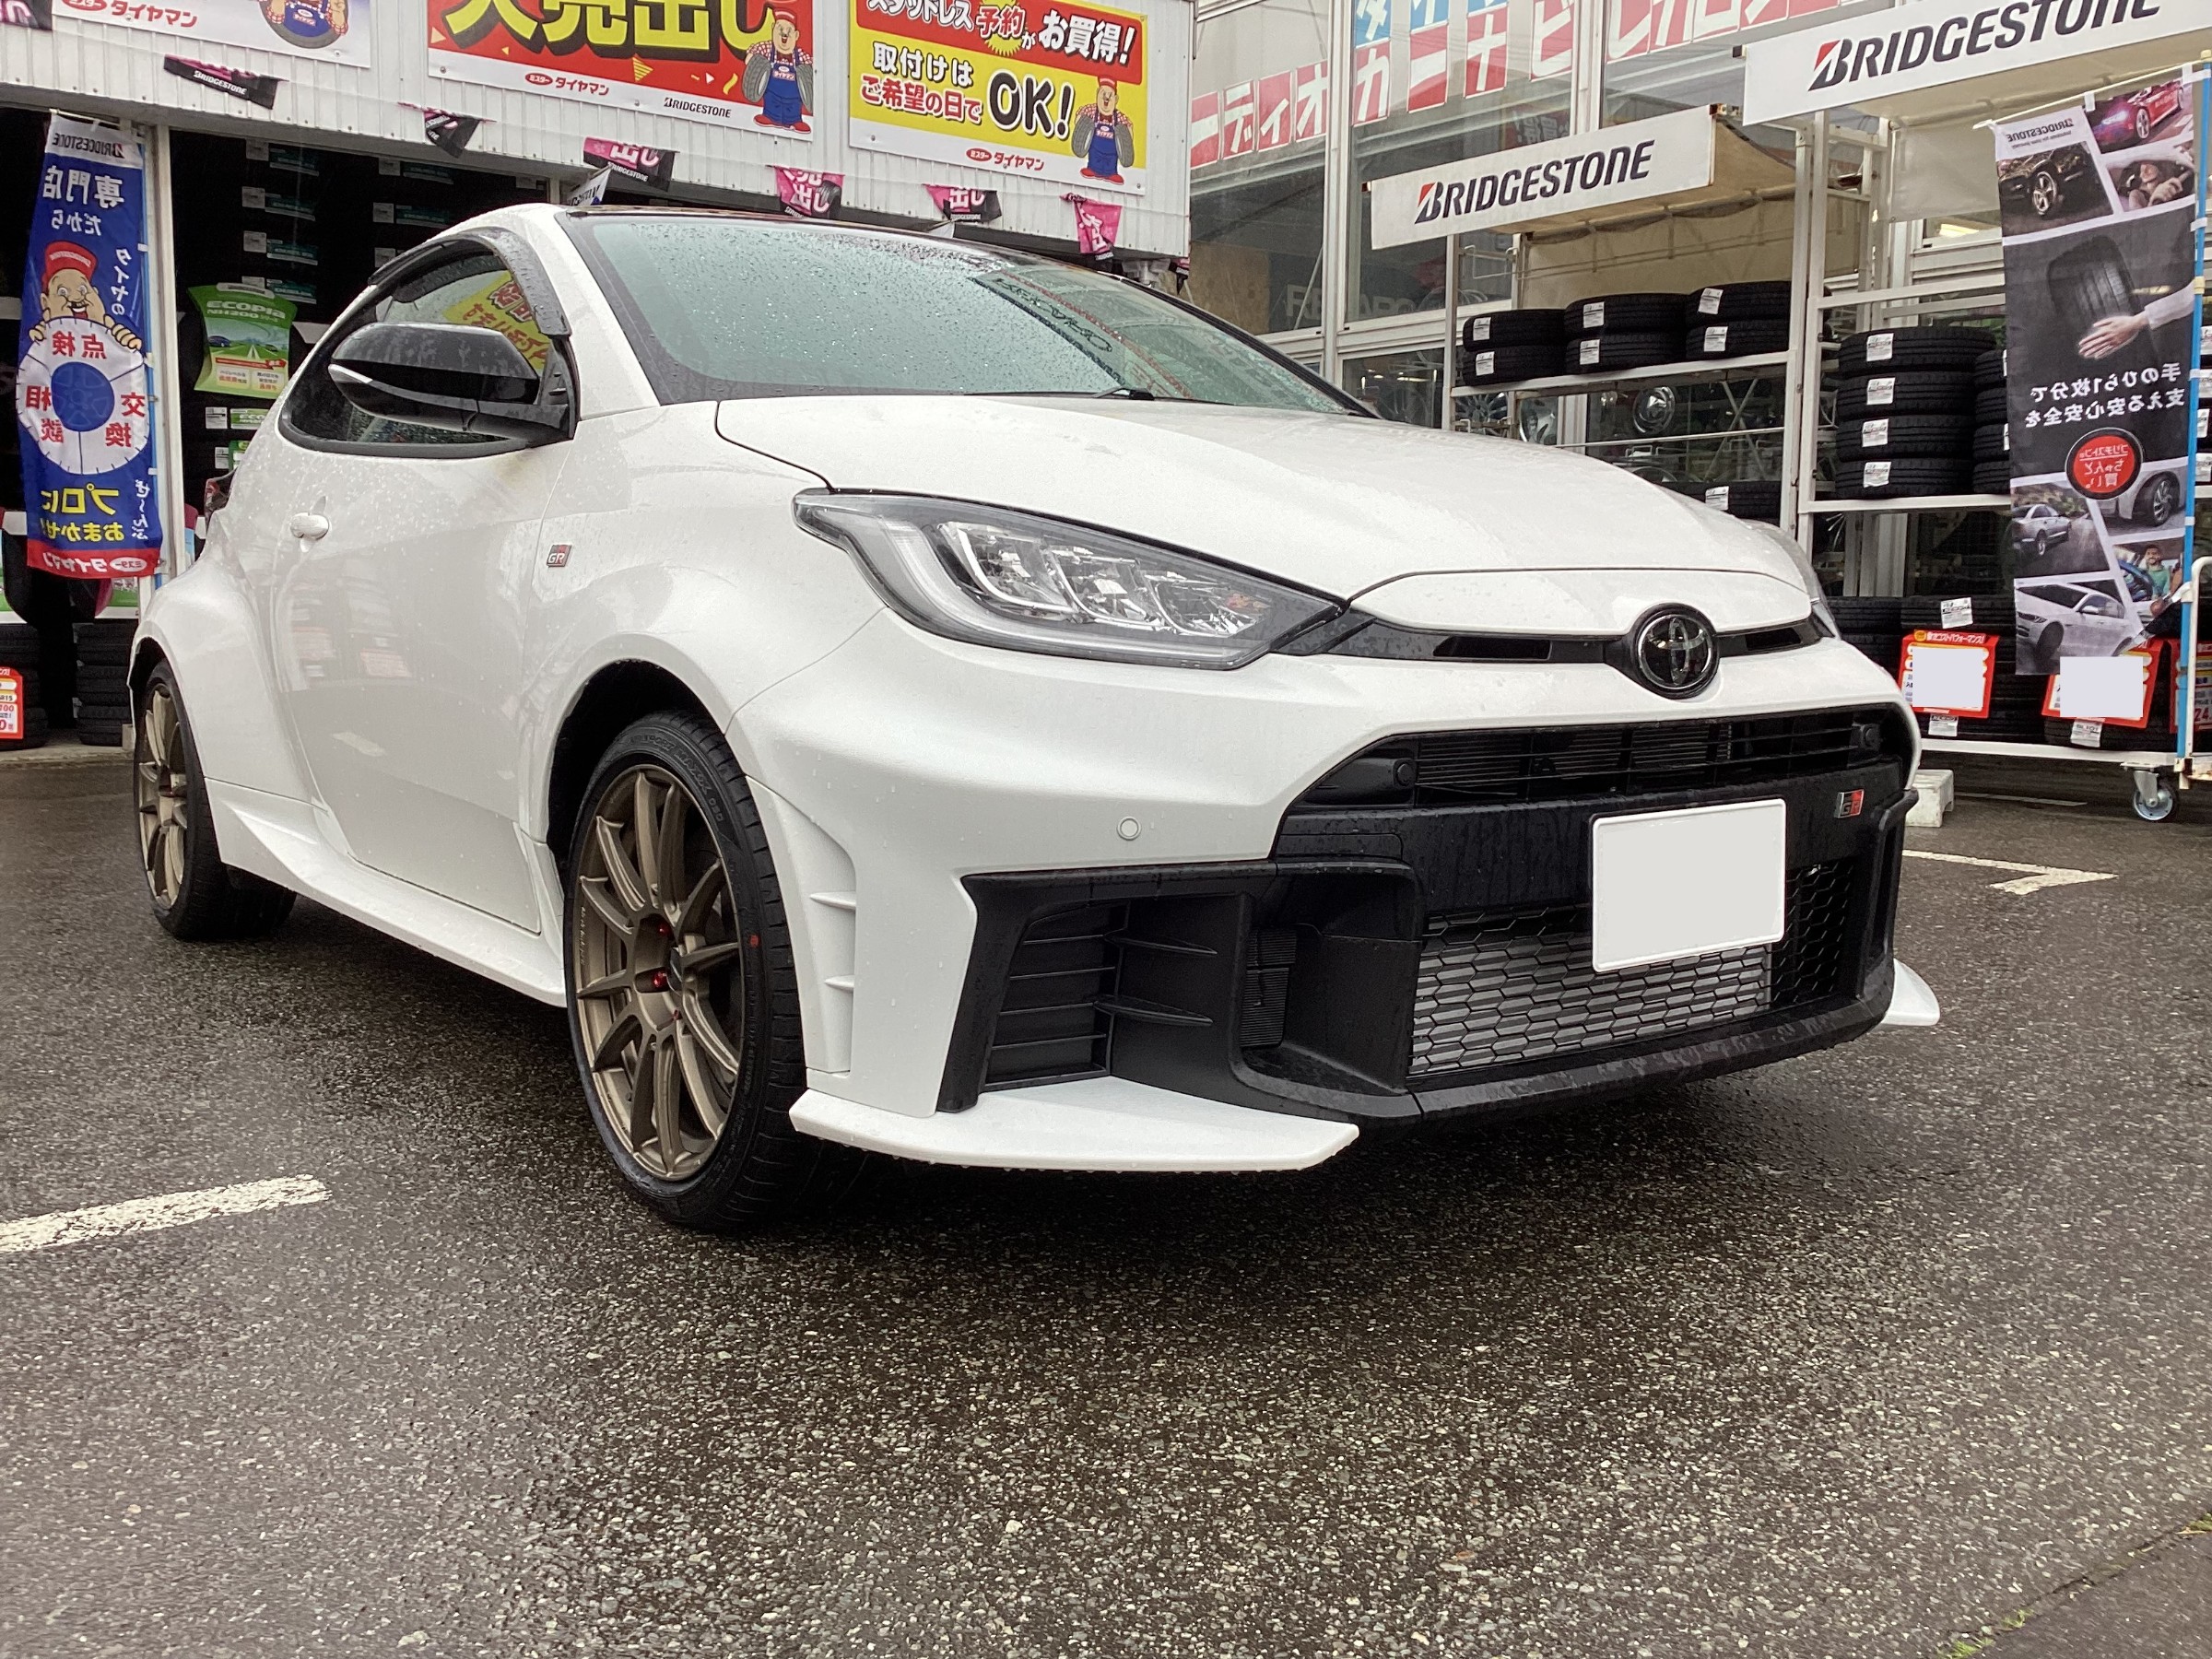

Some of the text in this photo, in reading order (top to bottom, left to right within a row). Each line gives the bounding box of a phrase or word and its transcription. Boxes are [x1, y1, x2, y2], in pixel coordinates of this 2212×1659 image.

[873, 42, 973, 85] 取付けは
[555, 76, 609, 95] タイヤマン
[862, 76, 982, 124] ご希望の日で
[664, 98, 731, 118] BRIDGESTONE
[989, 71, 1074, 139] OK!
[994, 152, 1044, 171] タイヤマン
[1415, 139, 1655, 225] BRIDGESTONE
[547, 553, 565, 564] GR
